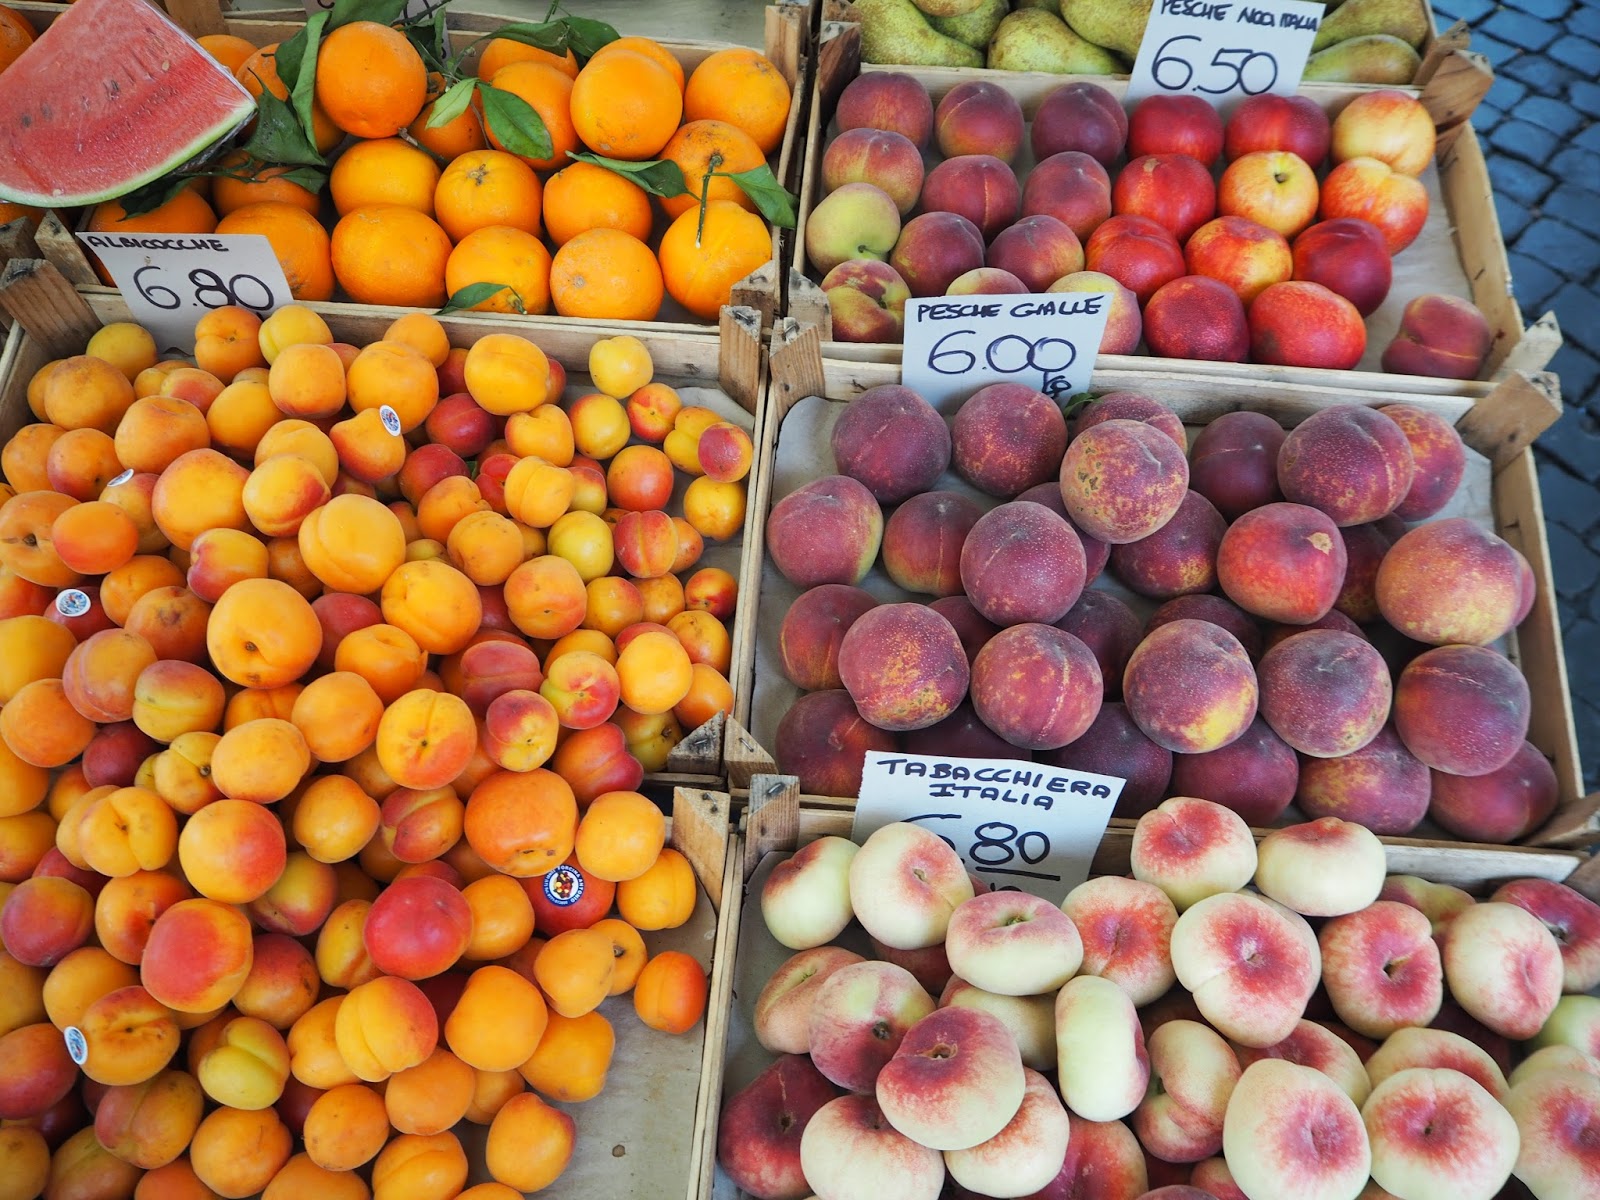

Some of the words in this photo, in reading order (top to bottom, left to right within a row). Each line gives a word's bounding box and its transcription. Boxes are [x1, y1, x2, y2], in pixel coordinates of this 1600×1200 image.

[1160, 0, 1233, 21] PESCHE
[1280, 13, 1318, 32] ITALIA
[1151, 35, 1278, 95] 6.50
[87, 234, 230, 252] ALBICOCCHE
[132, 265, 275, 311] 6.80
[917, 303, 1003, 322] PESCHE
[1010, 295, 1105, 318] GIALLE
[927, 330, 1077, 374] 6.00
[876, 758, 1111, 799] TABACCHIERA
[929, 782, 1054, 811] ITALIA
